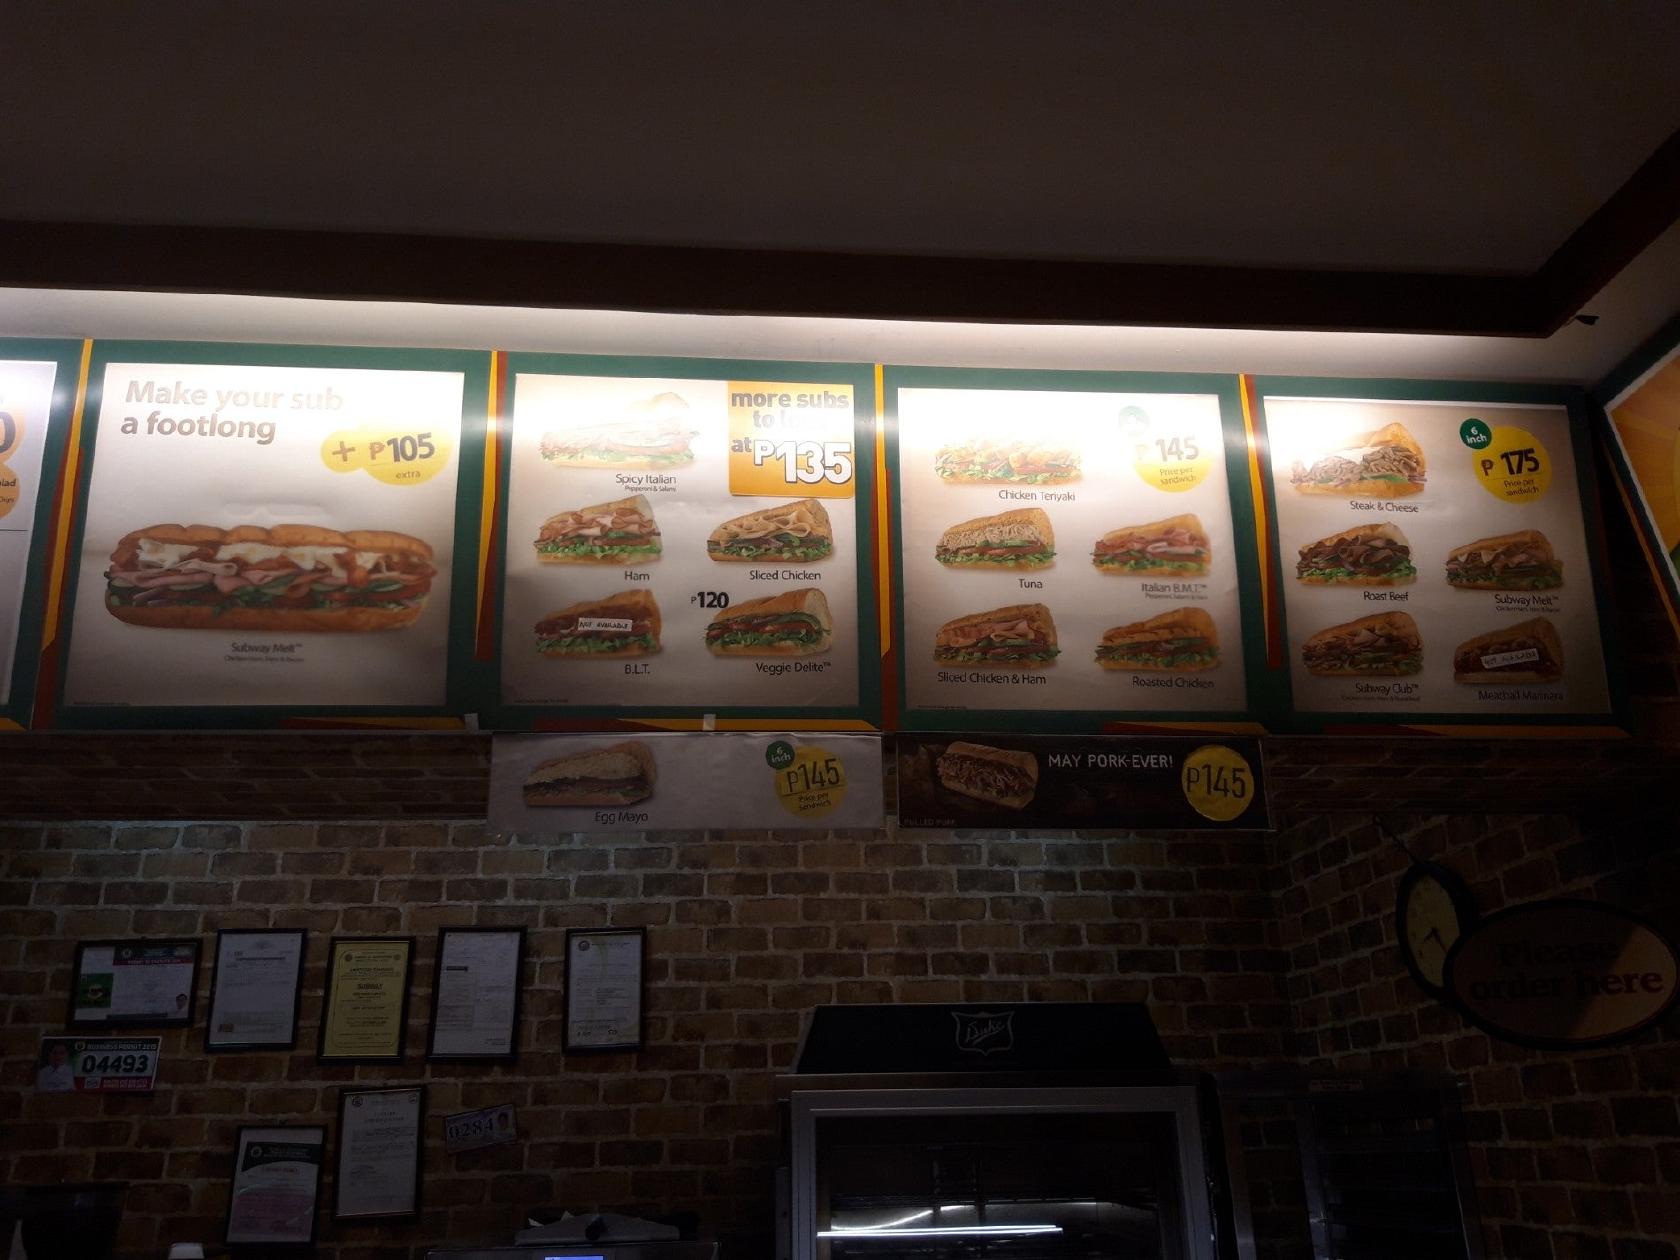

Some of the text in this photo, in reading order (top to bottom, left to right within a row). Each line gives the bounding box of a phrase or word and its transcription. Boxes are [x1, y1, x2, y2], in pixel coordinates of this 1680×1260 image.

[125, 380, 344, 412] Make your sub
[731, 391, 850, 409] more subs
[752, 410, 775, 428] to
[120, 410, 277, 446] a footlong
[1470, 427, 1478, 435] 6
[731, 437, 752, 453] at
[1465, 433, 1487, 444] inch
[1155, 436, 1200, 462] 145
[1500, 447, 1540, 475] 175
[395, 470, 421, 480] extra
[615, 473, 677, 485] Spicy Italian
[1160, 468, 1179, 477] Price
[1160, 474, 1197, 485] sandwich
[1504, 480, 1521, 488] Price
[998, 489, 1076, 502] Chicken Teriyaki
[1505, 486, 1539, 496] sandwich
[1350, 501, 1419, 513] Steak & Cheese
[624, 571, 650, 580] Ham
[749, 570, 821, 580] Sliced Chicken
[1019, 578, 1043, 589] Tuna
[1141, 583, 1171, 592] Italian
[1363, 590, 1409, 601] Roast Beef
[1494, 593, 1531, 606] Subway
[231, 641, 269, 654] Subway
[756, 662, 792, 676] Veggie
[937, 671, 1046, 685] Sliced Chicken & Ham
[1132, 675, 1173, 688] Roasted
[1355, 682, 1391, 696] Subway
[771, 752, 792, 763] inch
[1048, 753, 1081, 768] MAY
[595, 811, 649, 825] Egg Mayo
[1573, 969, 1665, 996] here
[82, 1054, 149, 1073] 04493
